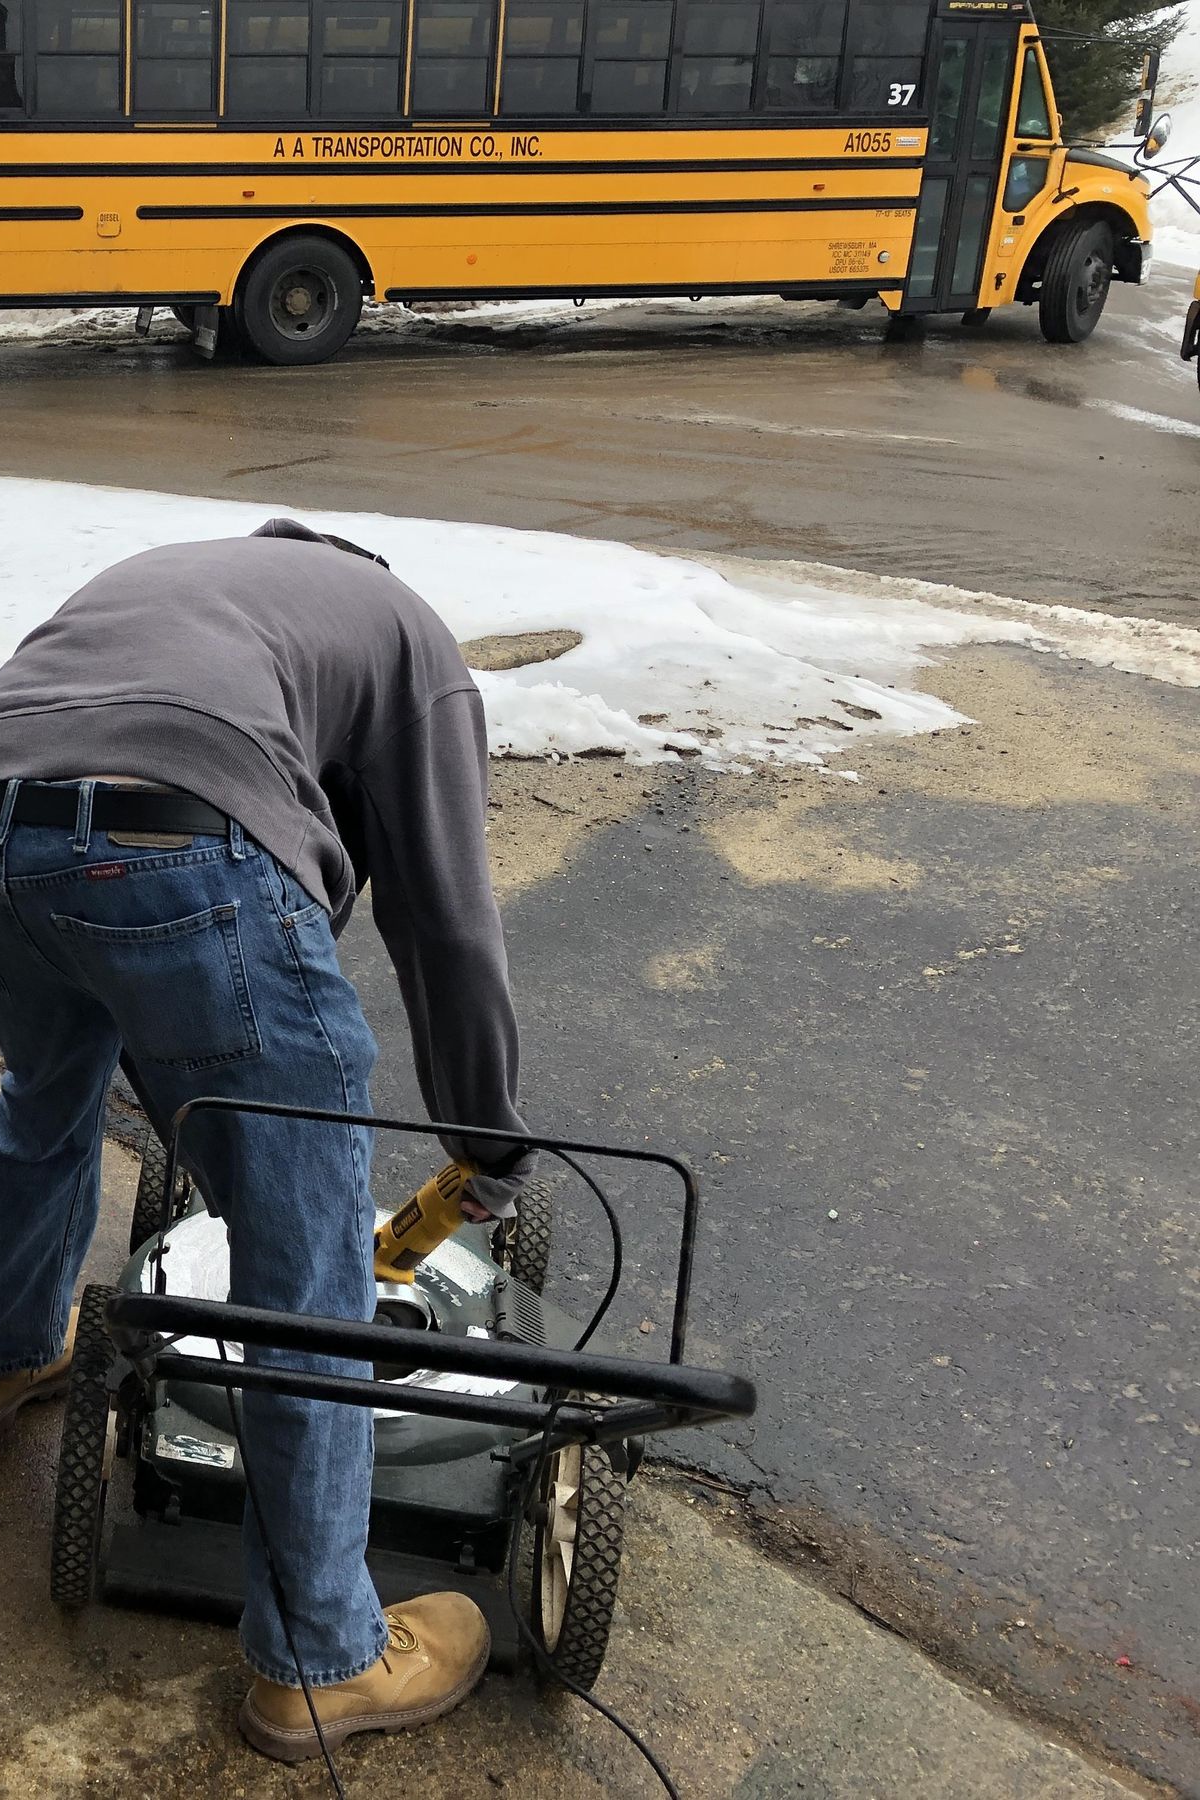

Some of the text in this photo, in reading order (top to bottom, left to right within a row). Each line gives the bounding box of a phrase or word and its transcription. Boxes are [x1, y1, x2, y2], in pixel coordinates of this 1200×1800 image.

[887, 83, 916, 106] 37
[273, 137, 285, 157] A
[292, 137, 304, 157] A
[312, 136, 462, 158] TRANSPORTATION
[511, 136, 543, 157] INC.
[843, 131, 892, 153] A1055
[100, 213, 119, 221] DIESEL
